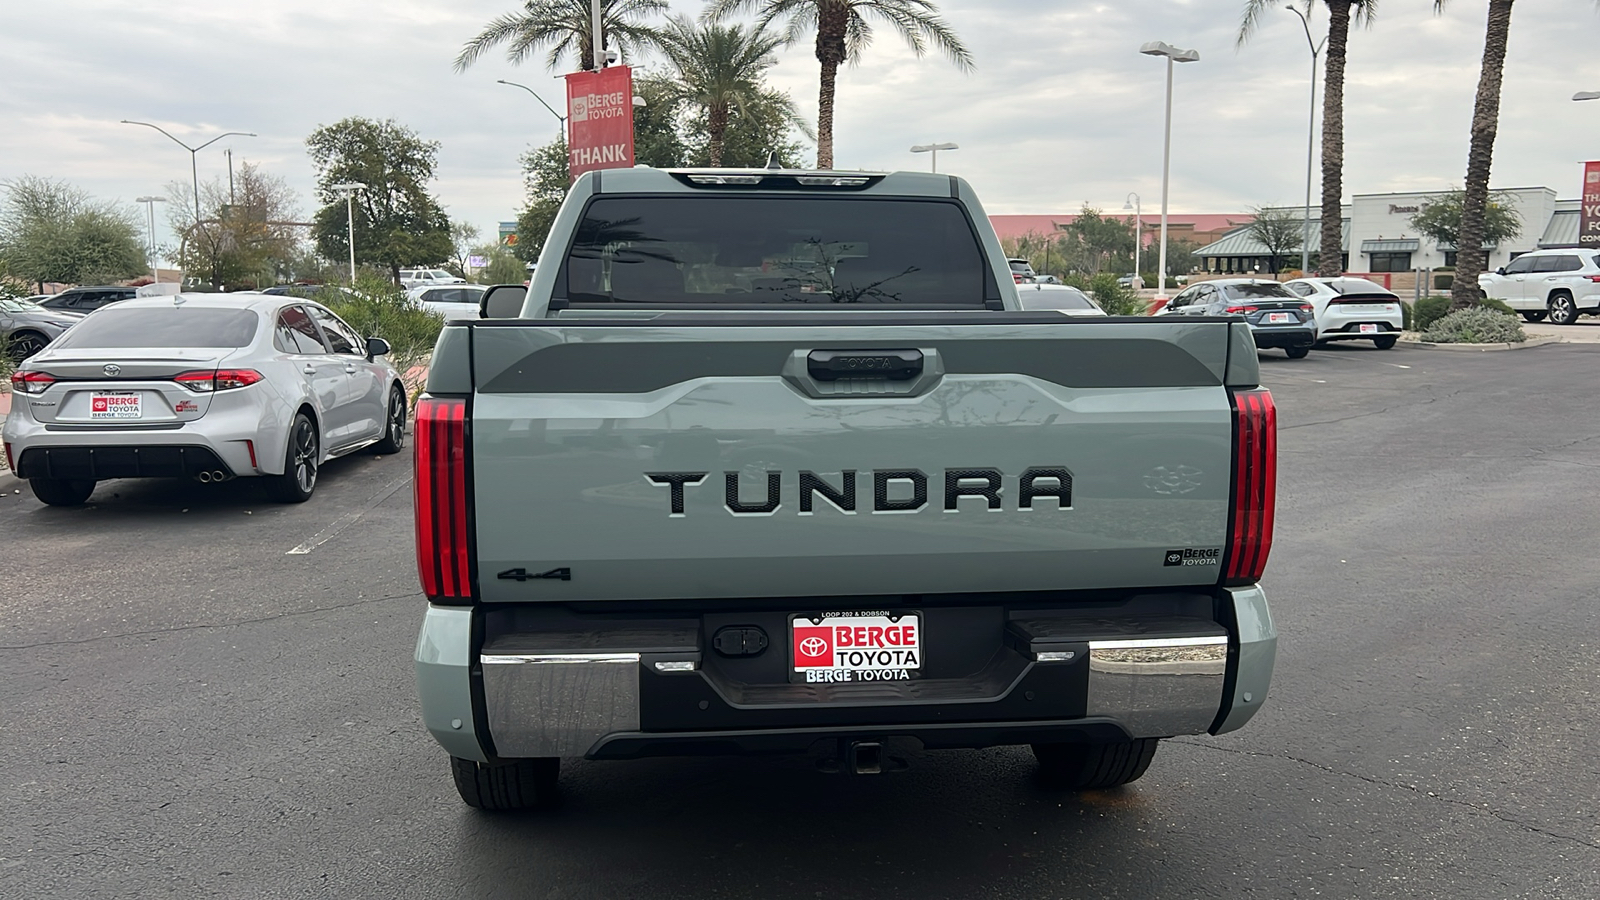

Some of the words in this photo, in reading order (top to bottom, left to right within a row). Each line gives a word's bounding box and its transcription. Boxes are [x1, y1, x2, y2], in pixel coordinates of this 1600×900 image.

[588, 92, 624, 109] BERGE
[588, 107, 624, 120] TOYOTA
[572, 143, 627, 166] THANK
[840, 357, 892, 369] TOYOTA
[108, 397, 139, 405] BERGE
[643, 465, 1075, 518] TUNDRA
[1183, 548, 1220, 558] BERGE
[1182, 558, 1217, 566] TOYOTA
[836, 626, 916, 648] BERGE
[836, 651, 918, 667] TOYOTA
[806, 669, 851, 683] BERGE
[856, 669, 910, 681] TOYOTA
